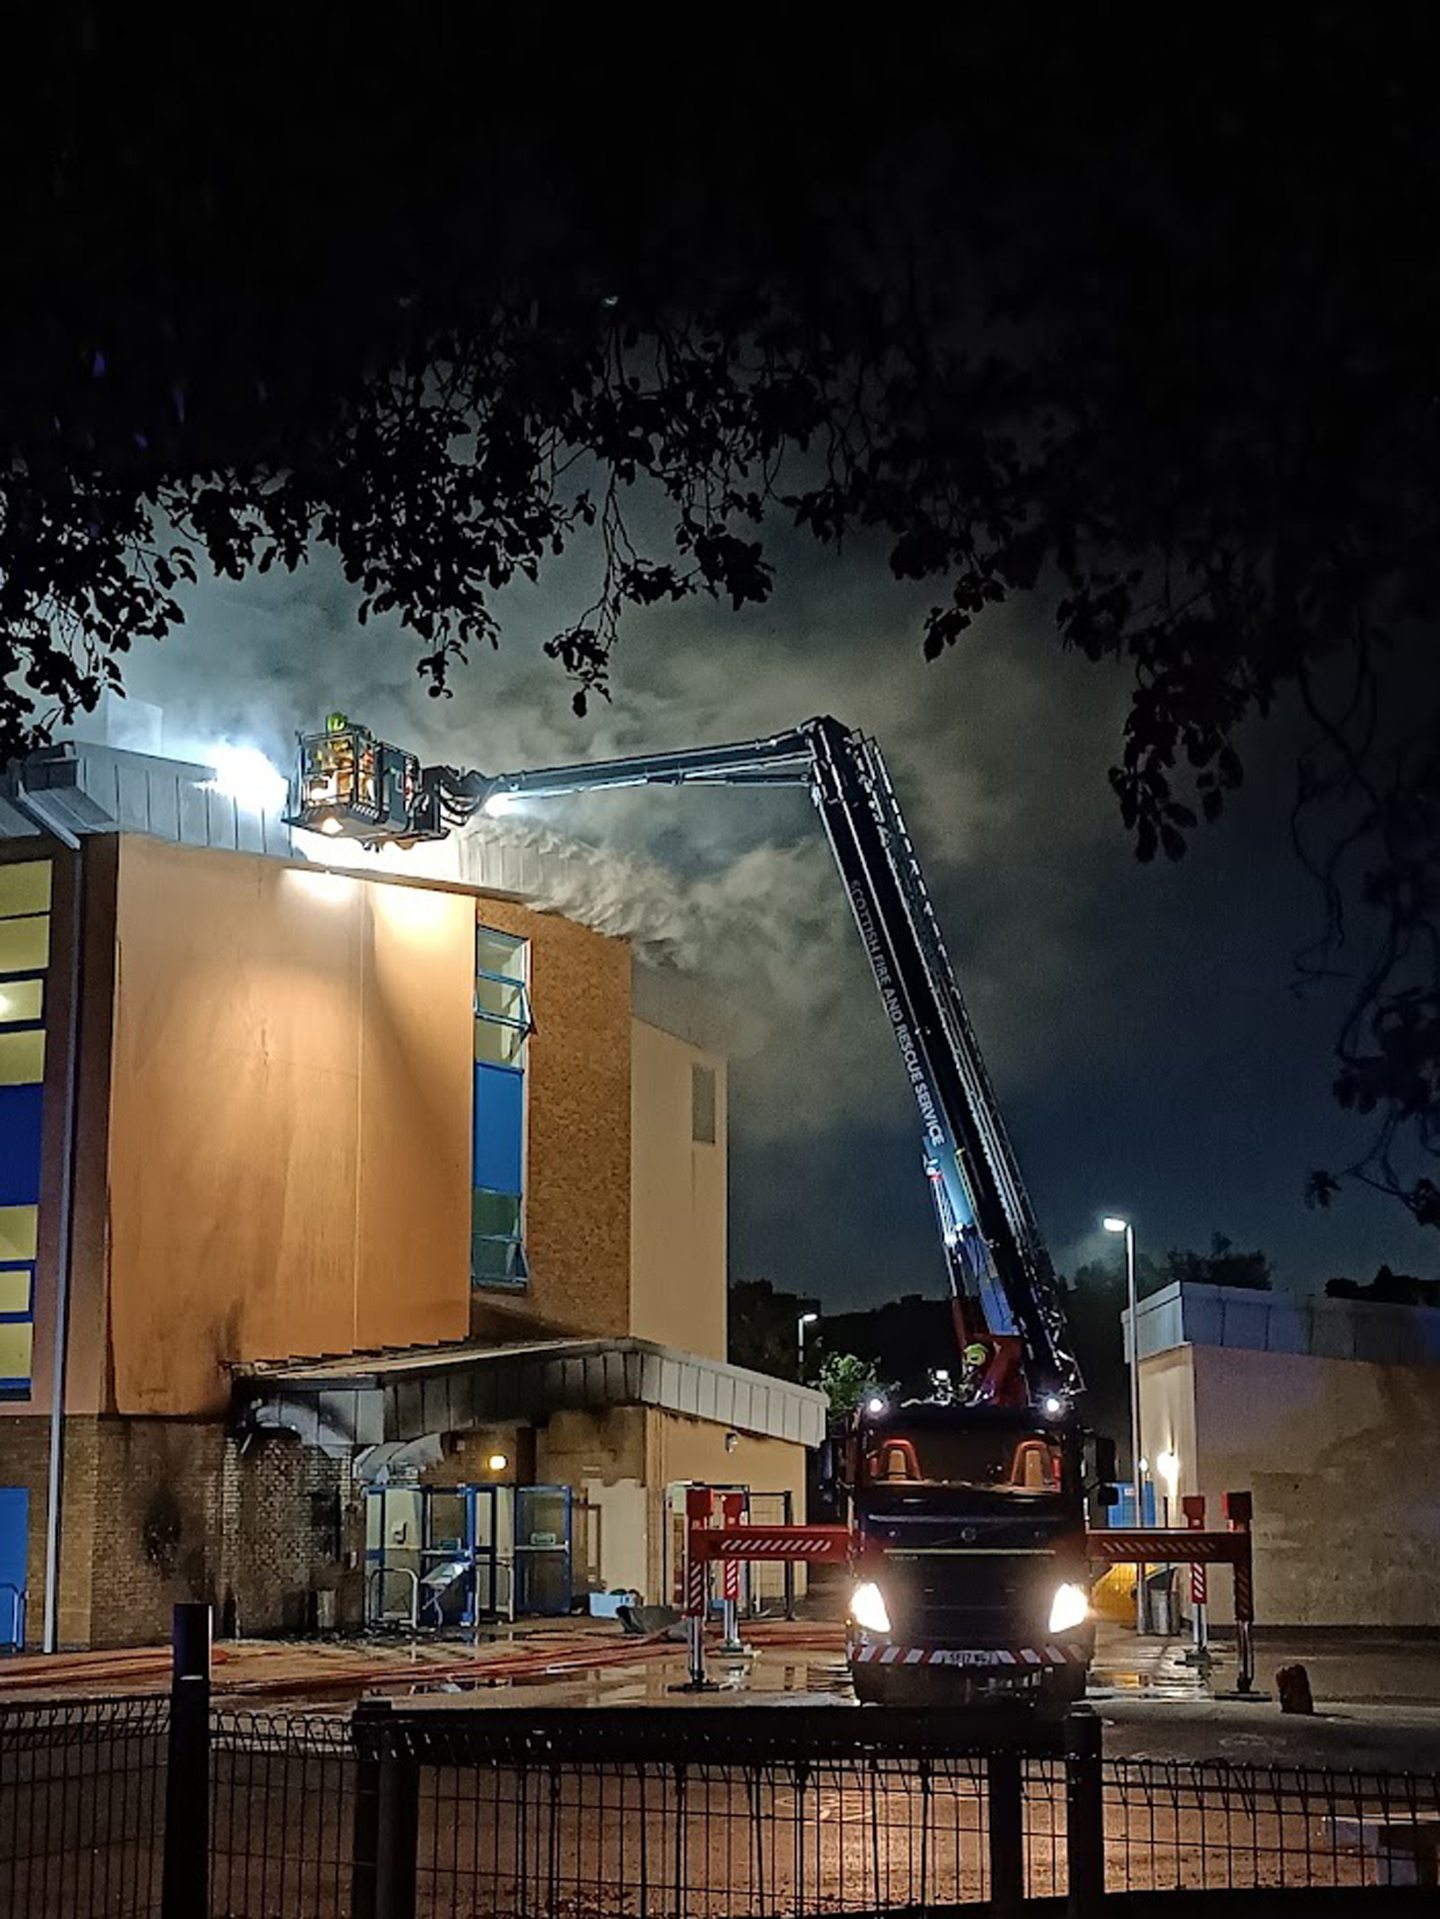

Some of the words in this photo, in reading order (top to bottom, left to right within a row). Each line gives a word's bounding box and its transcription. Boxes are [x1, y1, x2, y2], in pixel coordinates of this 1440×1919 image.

[873, 953, 892, 985] FIRE
[884, 988, 904, 1022] AND
[895, 1023, 925, 1083] RESCUE
[915, 1082, 945, 1147] SERVICE
